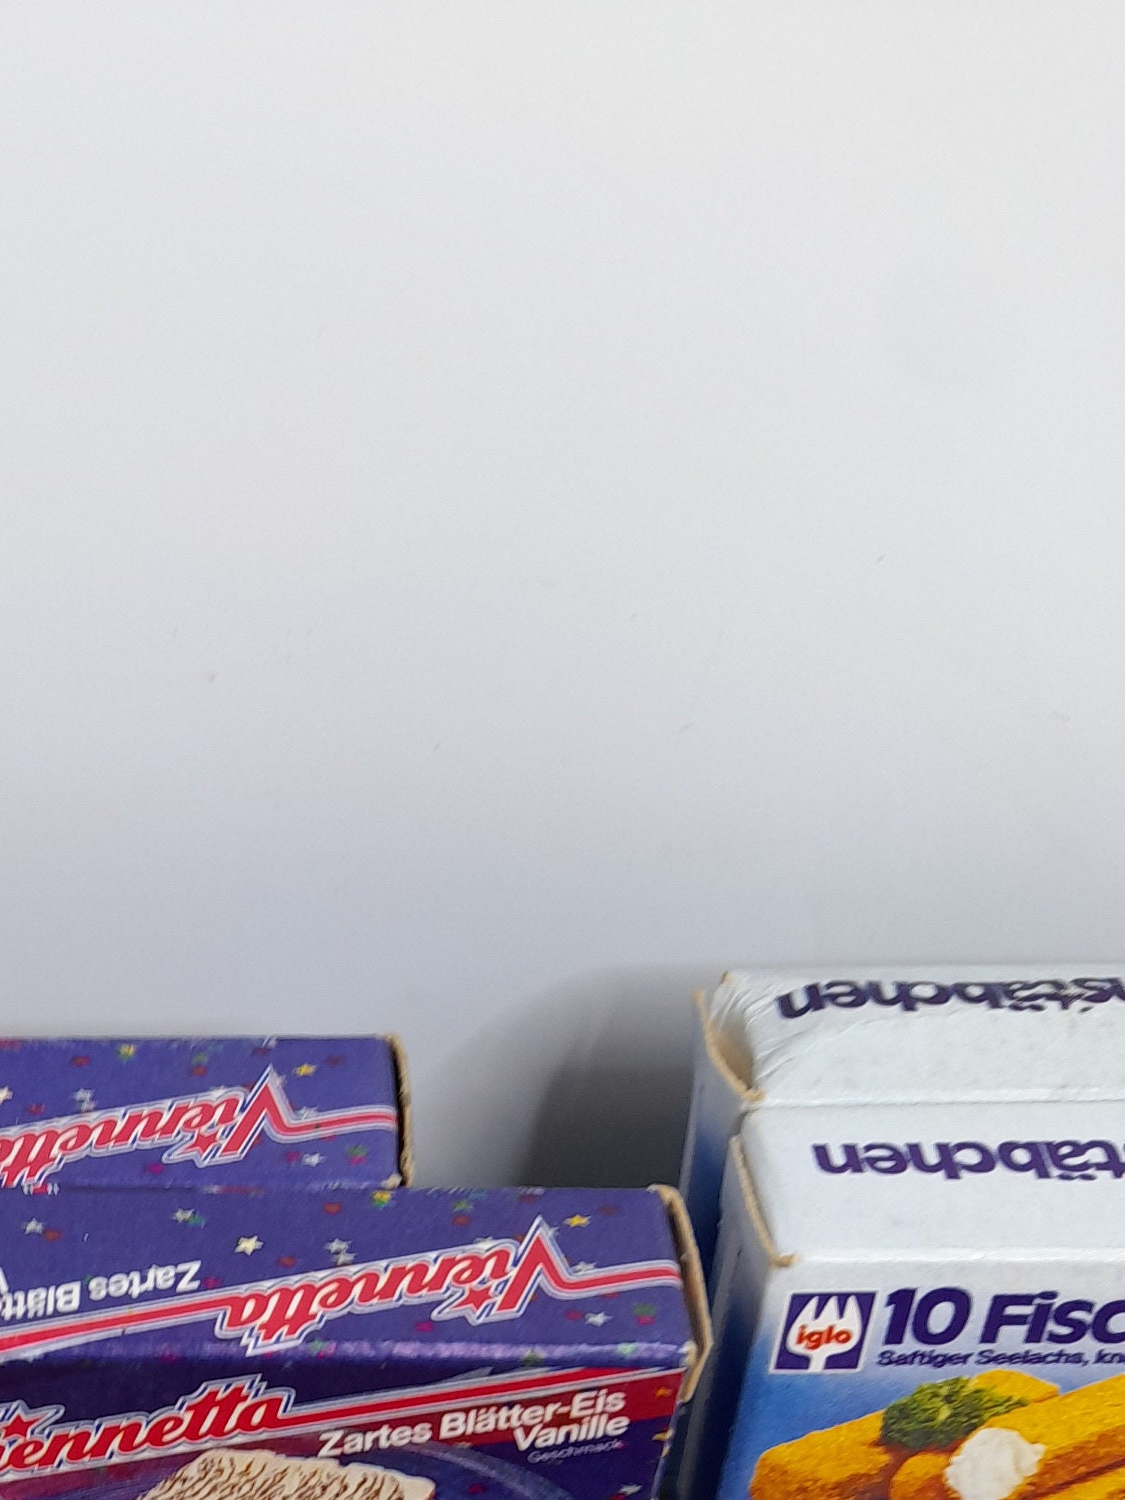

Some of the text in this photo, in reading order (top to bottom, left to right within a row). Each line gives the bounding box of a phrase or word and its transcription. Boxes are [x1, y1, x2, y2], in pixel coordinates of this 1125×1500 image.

[777, 977, 1125, 1020] stäbchen
[88, 1259, 202, 1300] Zartes
[215, 1215, 567, 1357] Viennetta
[795, 1323, 852, 1351] iglo
[883, 1287, 1125, 1346] 10 Fisc
[317, 1388, 626, 1459] Zartes Blätter-Eis
[513, 1413, 631, 1452] Vanille
